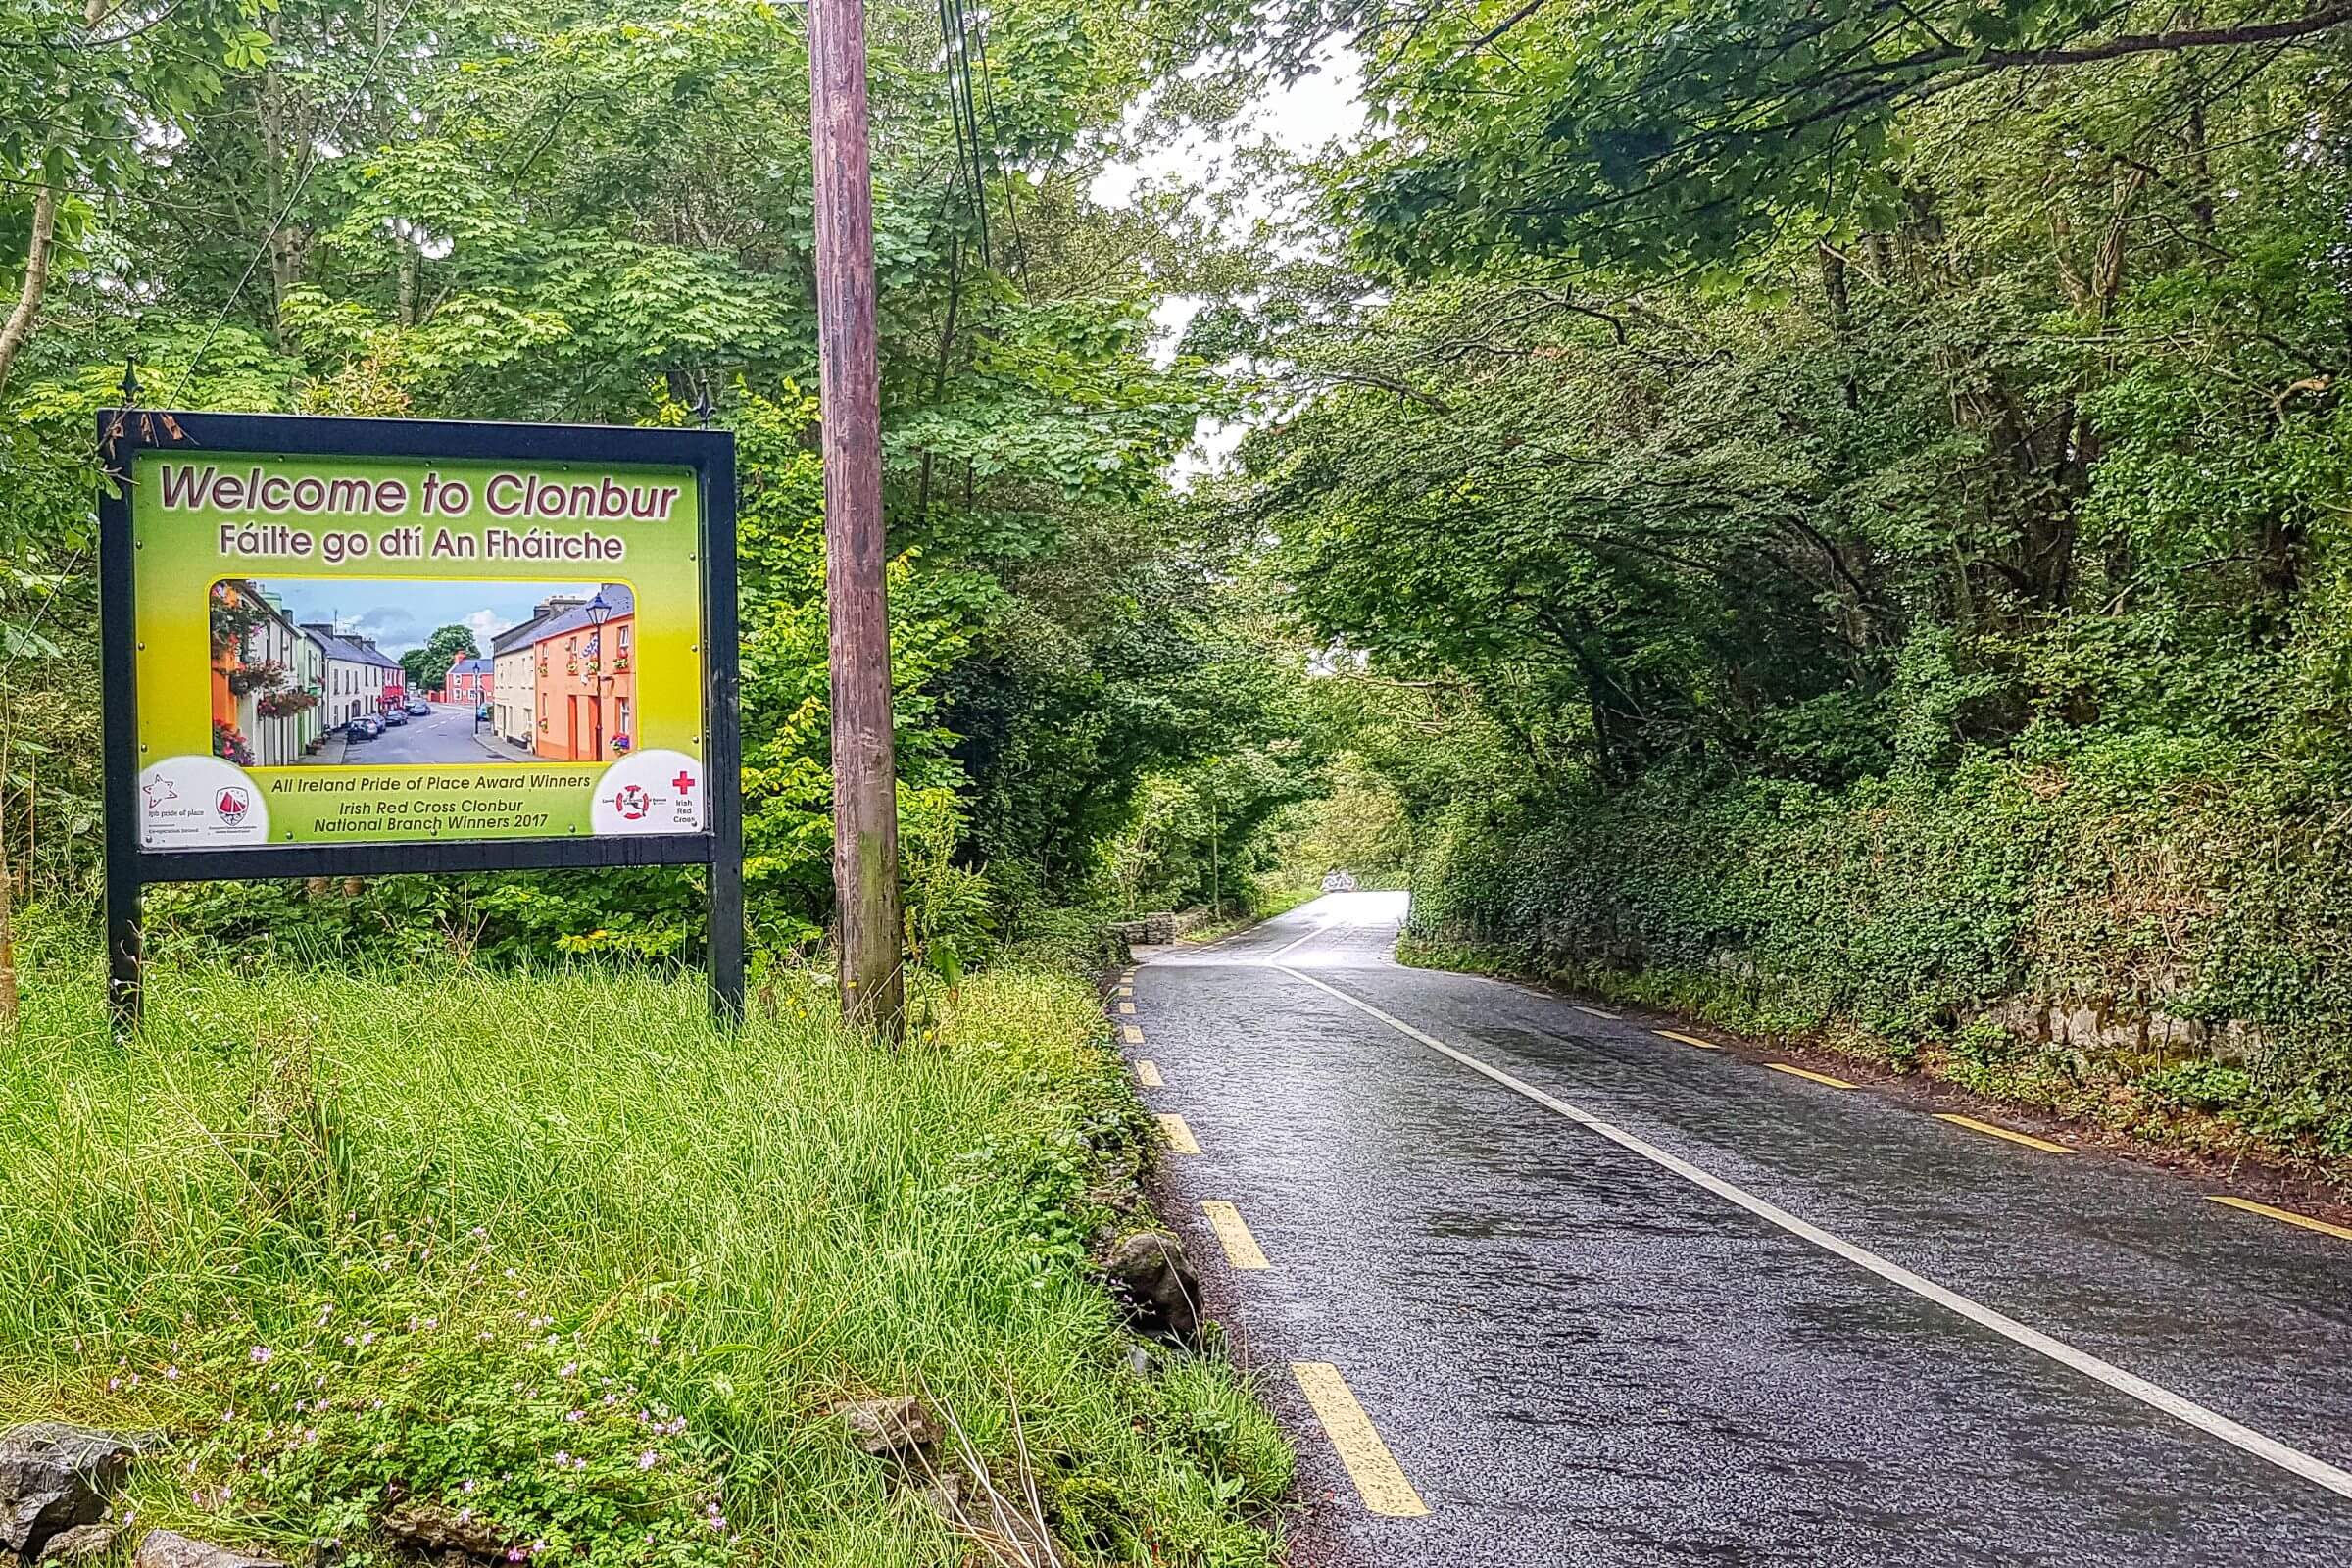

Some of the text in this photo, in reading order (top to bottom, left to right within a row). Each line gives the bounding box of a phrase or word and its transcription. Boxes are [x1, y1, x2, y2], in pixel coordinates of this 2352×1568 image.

[161, 465, 678, 518] Welcome to Clonbur
[220, 521, 623, 564] Fáilte go dtí An Fháirche
[271, 774, 591, 793] All Ireland Pride of Place Award Winners
[339, 798, 524, 815] Irish Red Cross Clonbur
[314, 813, 549, 833] National Branch Winners 2017
